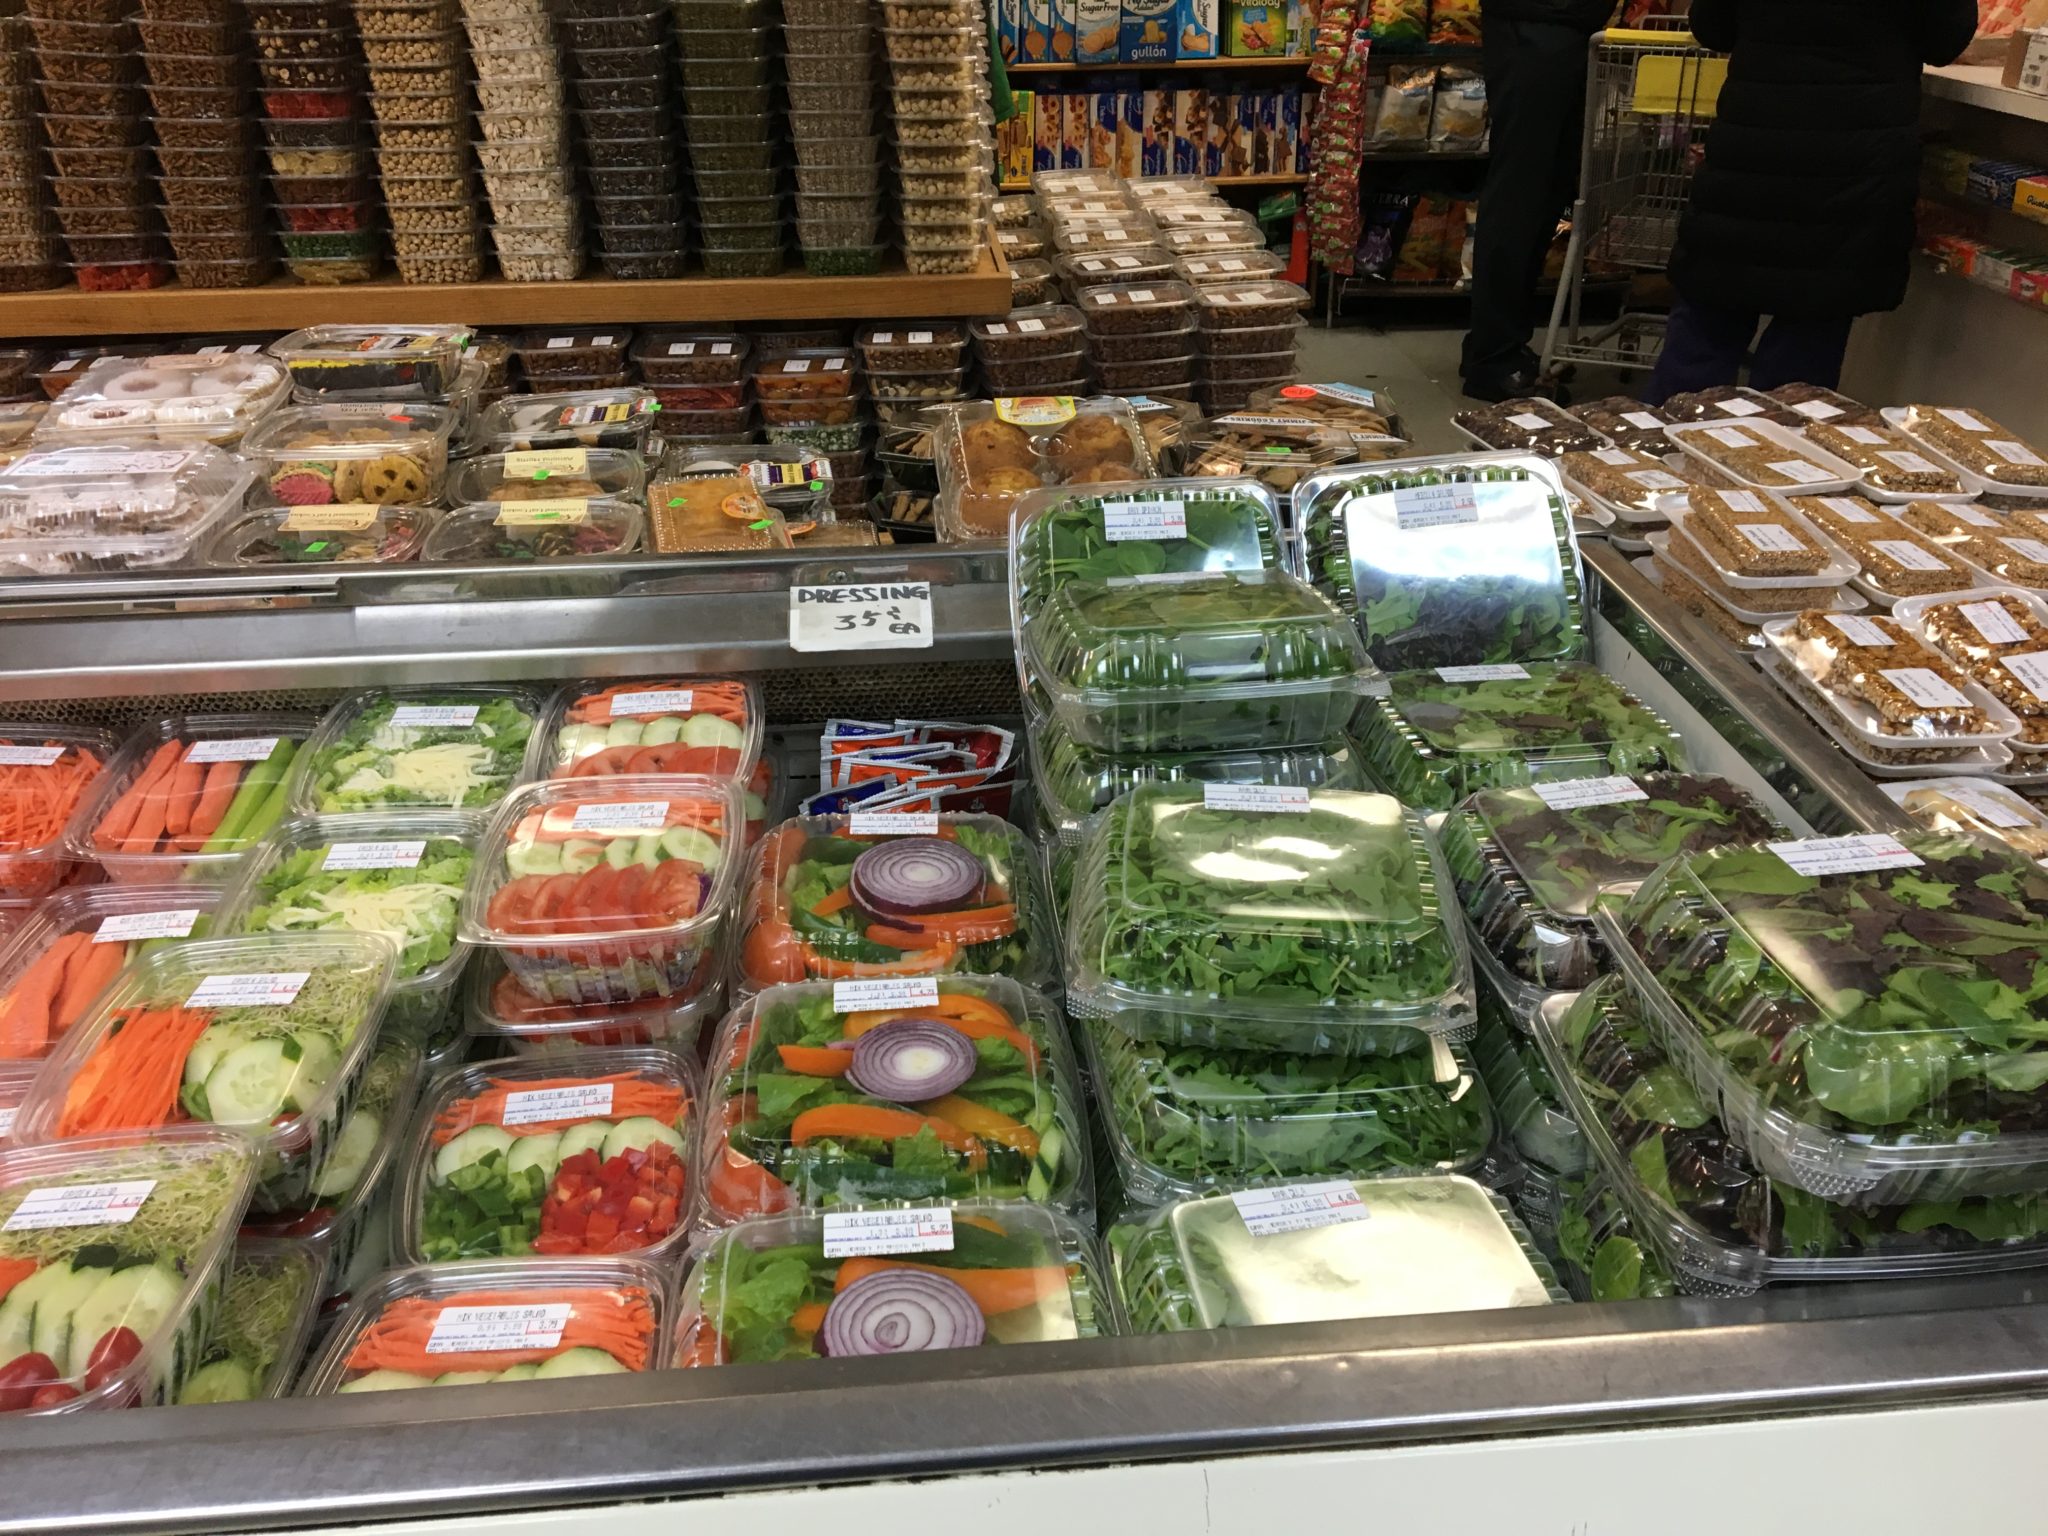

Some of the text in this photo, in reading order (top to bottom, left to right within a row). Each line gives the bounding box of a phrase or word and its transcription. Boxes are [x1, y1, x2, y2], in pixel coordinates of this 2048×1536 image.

[1080, 2, 1119, 14] Sugar Free
[1131, 45, 1167, 60] gullón
[798, 585, 930, 603] DRESSING
